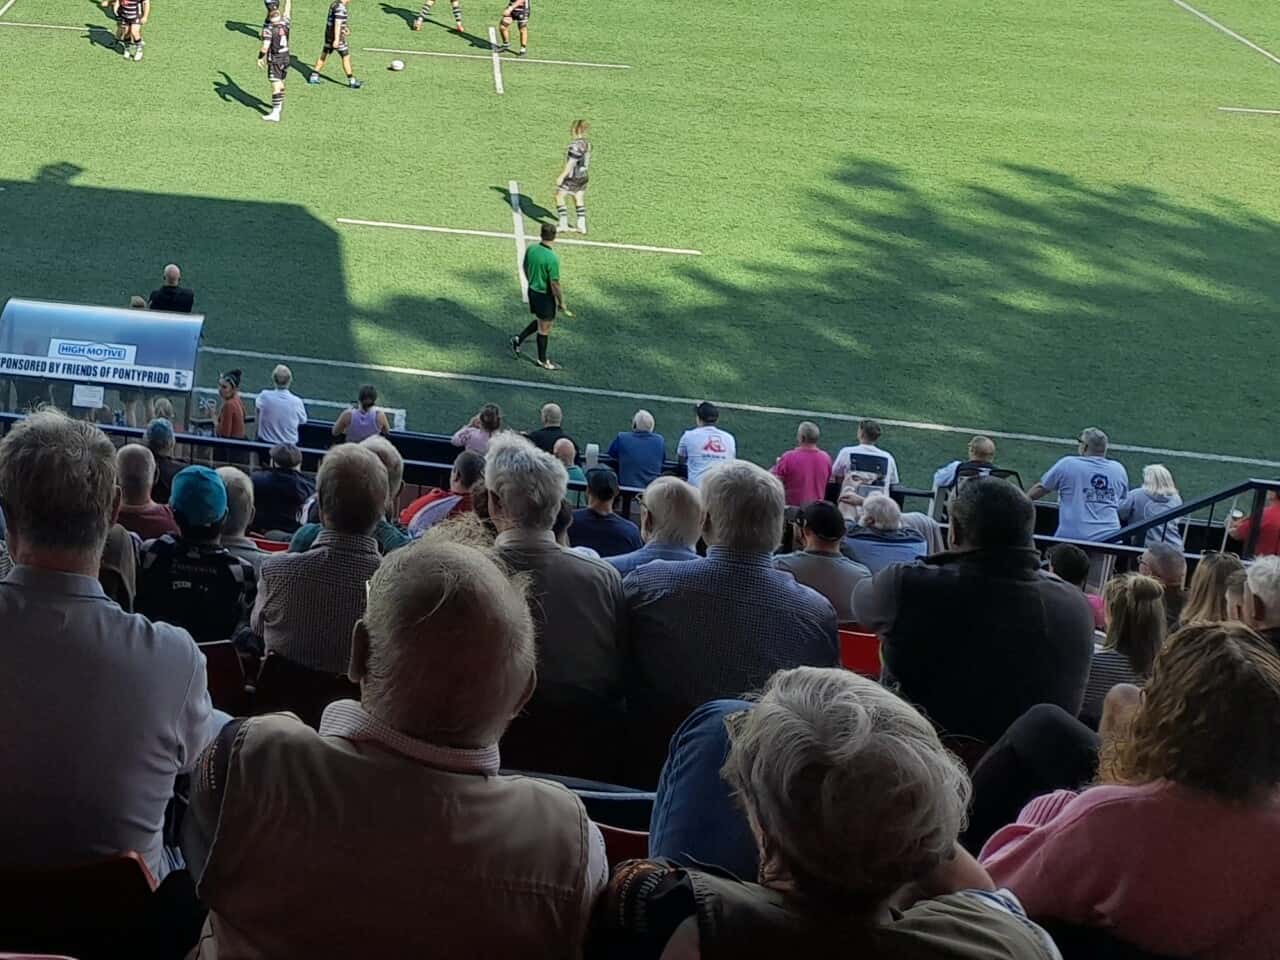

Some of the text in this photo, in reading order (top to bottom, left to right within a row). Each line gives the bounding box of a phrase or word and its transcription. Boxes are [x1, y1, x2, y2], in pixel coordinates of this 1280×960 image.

[61, 344, 123, 358] HIGH MOTIVE
[48, 361, 61, 373] BY
[61, 363, 98, 377] FRIENDS
[100, 366, 110, 377] OF
[112, 367, 170, 384] PONTYPRIDD
